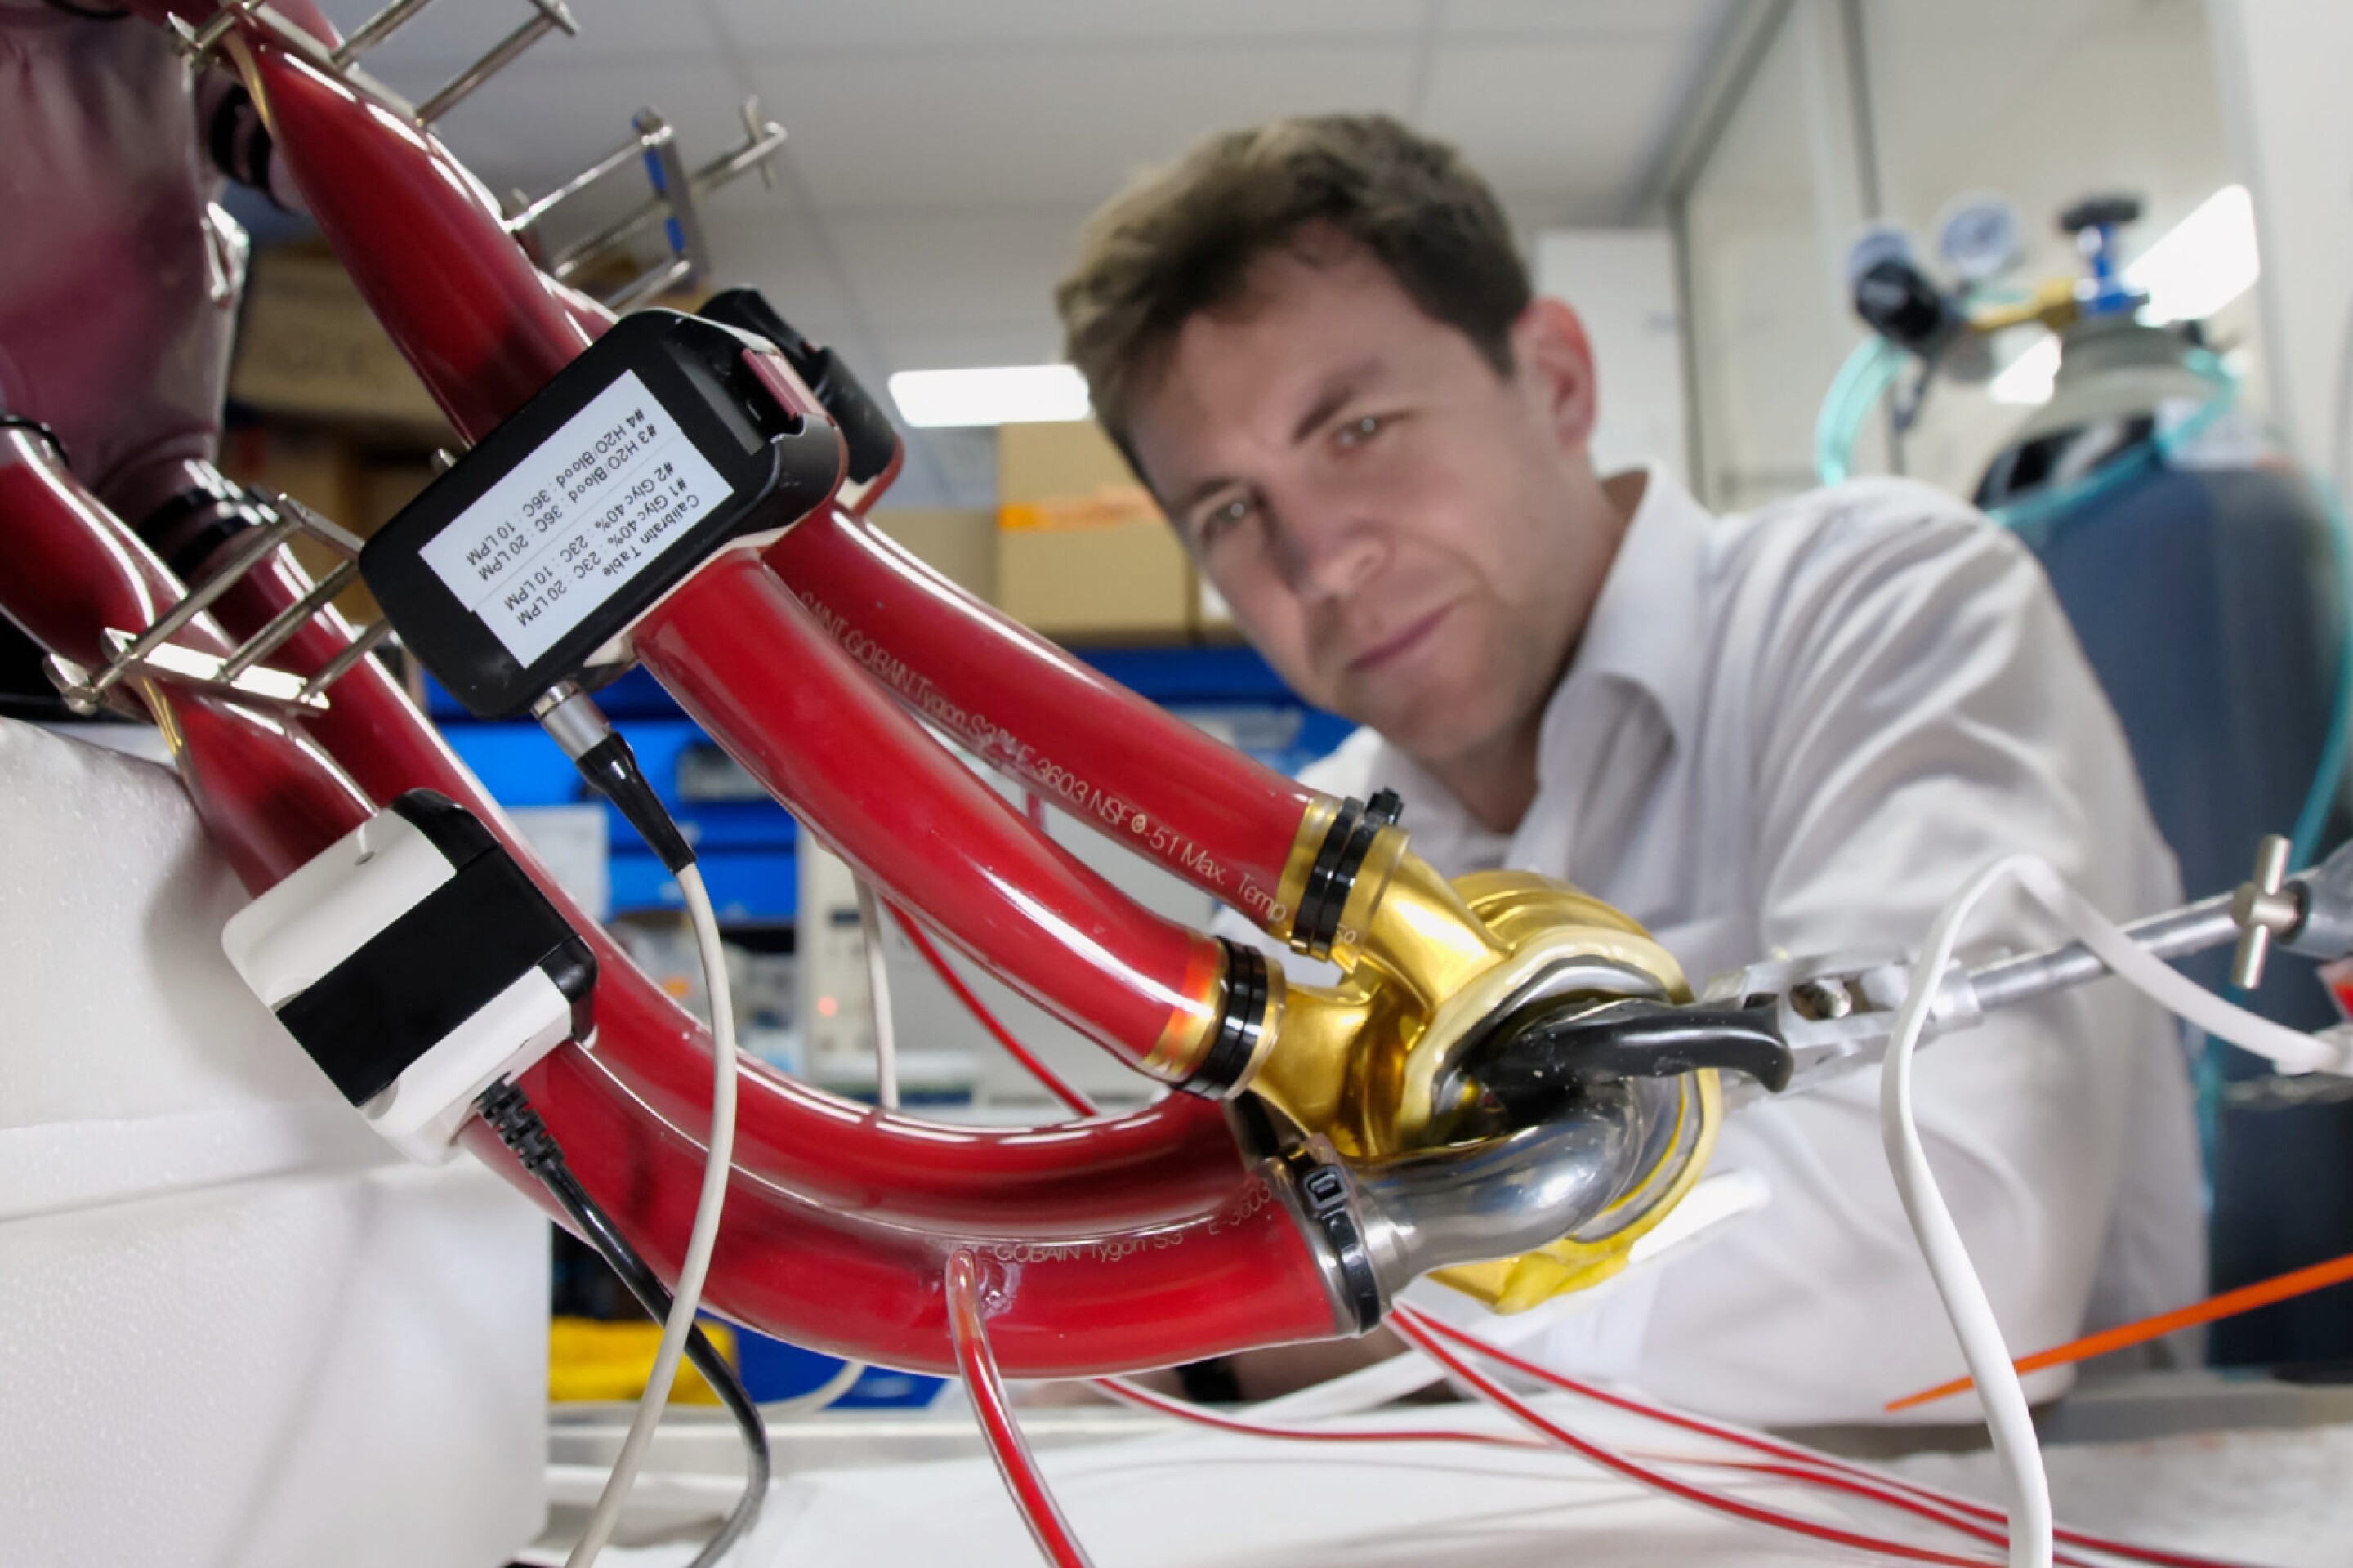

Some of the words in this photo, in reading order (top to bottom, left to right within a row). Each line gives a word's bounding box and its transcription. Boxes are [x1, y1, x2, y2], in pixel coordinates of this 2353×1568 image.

[625, 408, 645, 429] #4
[637, 423, 657, 444] #3
[654, 462, 673, 481] #2
[624, 479, 655, 505] Glyc
[668, 477, 687, 497] #1
[523, 490, 551, 517] 36C
[637, 495, 668, 520] Glyc
[497, 521, 516, 539] 10
[534, 505, 562, 533] 36C
[594, 504, 624, 532] 40%
[509, 534, 528, 555] 20
[607, 520, 636, 547] 40%
[466, 535, 498, 566] LPM
[560, 535, 588, 562] 23C
[602, 545, 641, 576] Table
[478, 551, 511, 581] LPM
[534, 566, 553, 585] 10
[573, 551, 601, 579] 23C
[504, 580, 536, 611] LPM
[547, 580, 567, 601] 20
[517, 596, 548, 627] LPM
[1179, 842, 1225, 885] Max.
